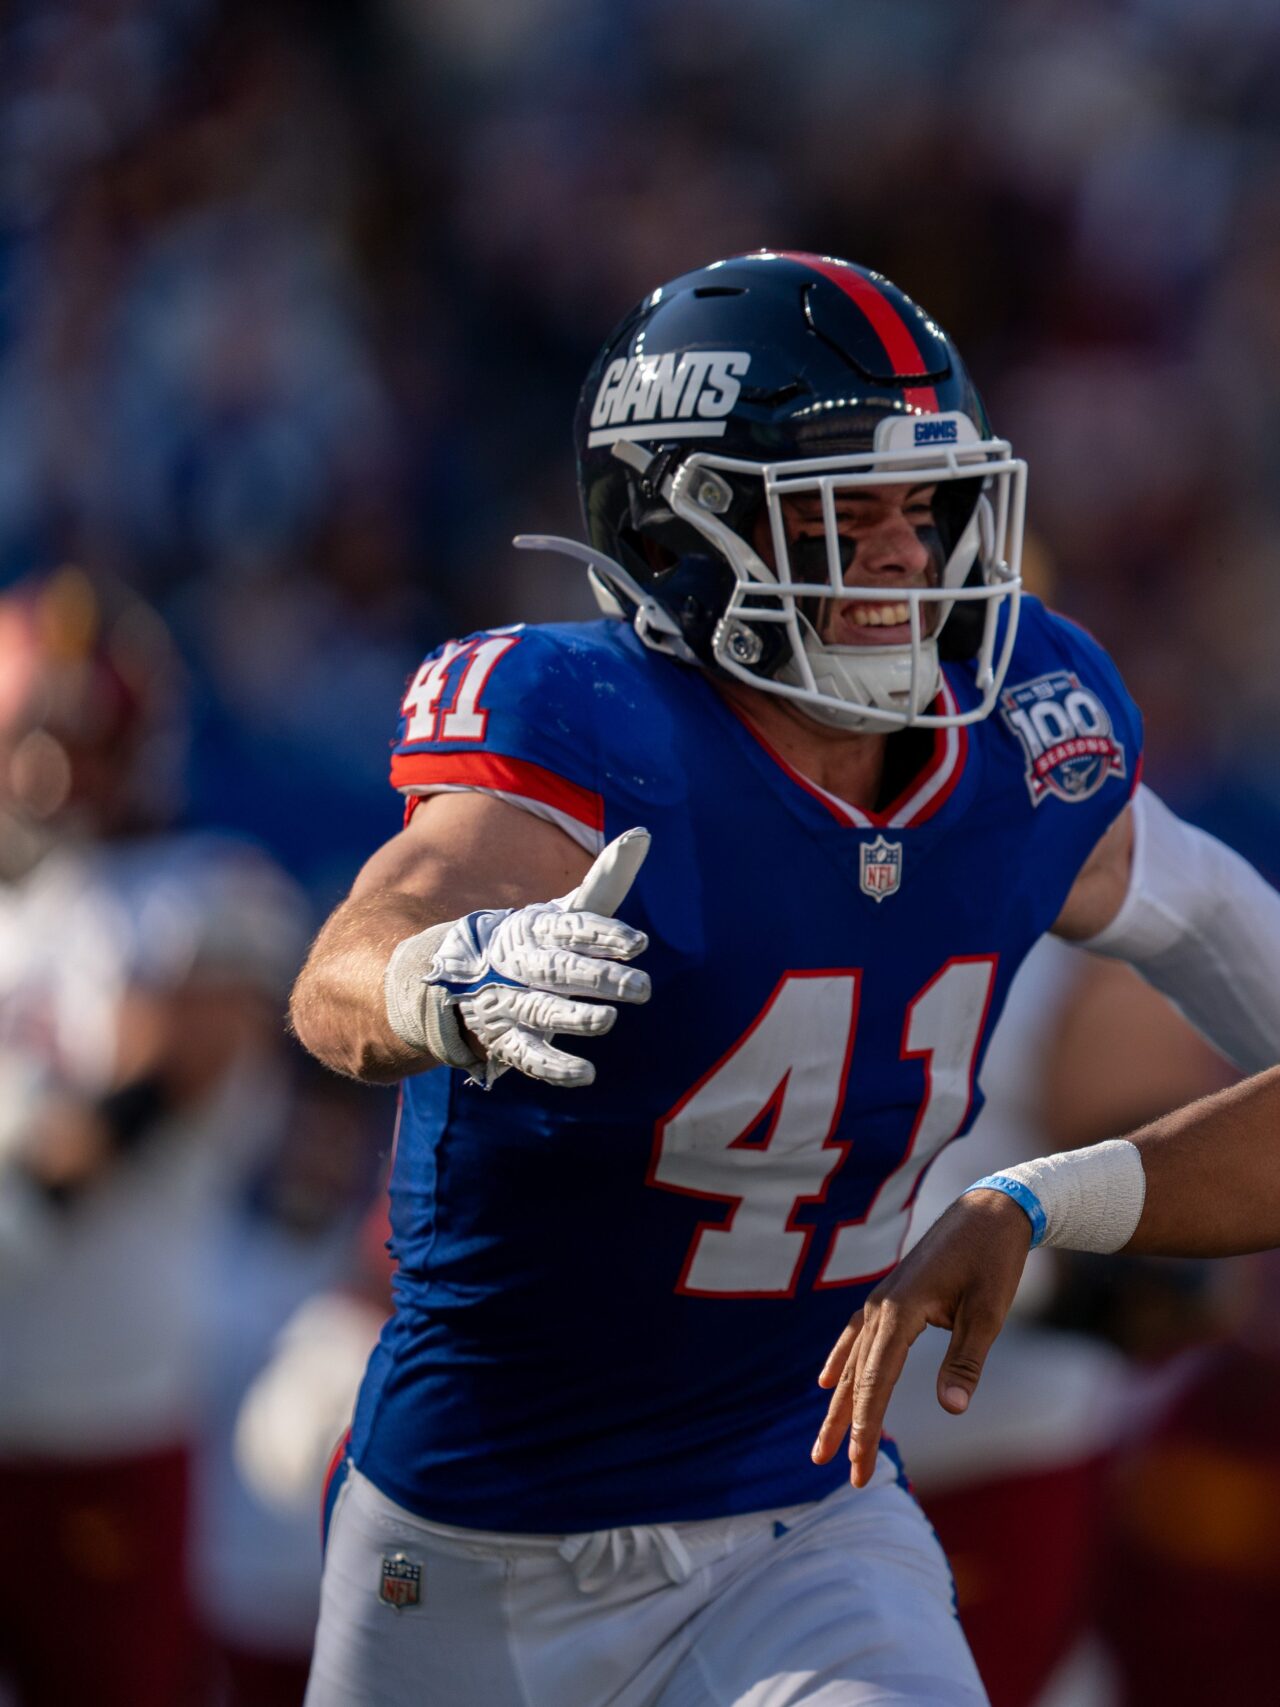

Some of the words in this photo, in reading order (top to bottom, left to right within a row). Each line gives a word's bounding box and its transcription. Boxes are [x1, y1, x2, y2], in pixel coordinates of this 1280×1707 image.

[589, 351, 751, 430] GIANTS
[914, 420, 957, 442] GIANTS
[401, 634, 521, 747] 41
[1009, 689, 1111, 762] 100
[1037, 737, 1111, 773] SEASONS
[866, 865, 896, 892] NFL
[644, 952, 1000, 1299] 41
